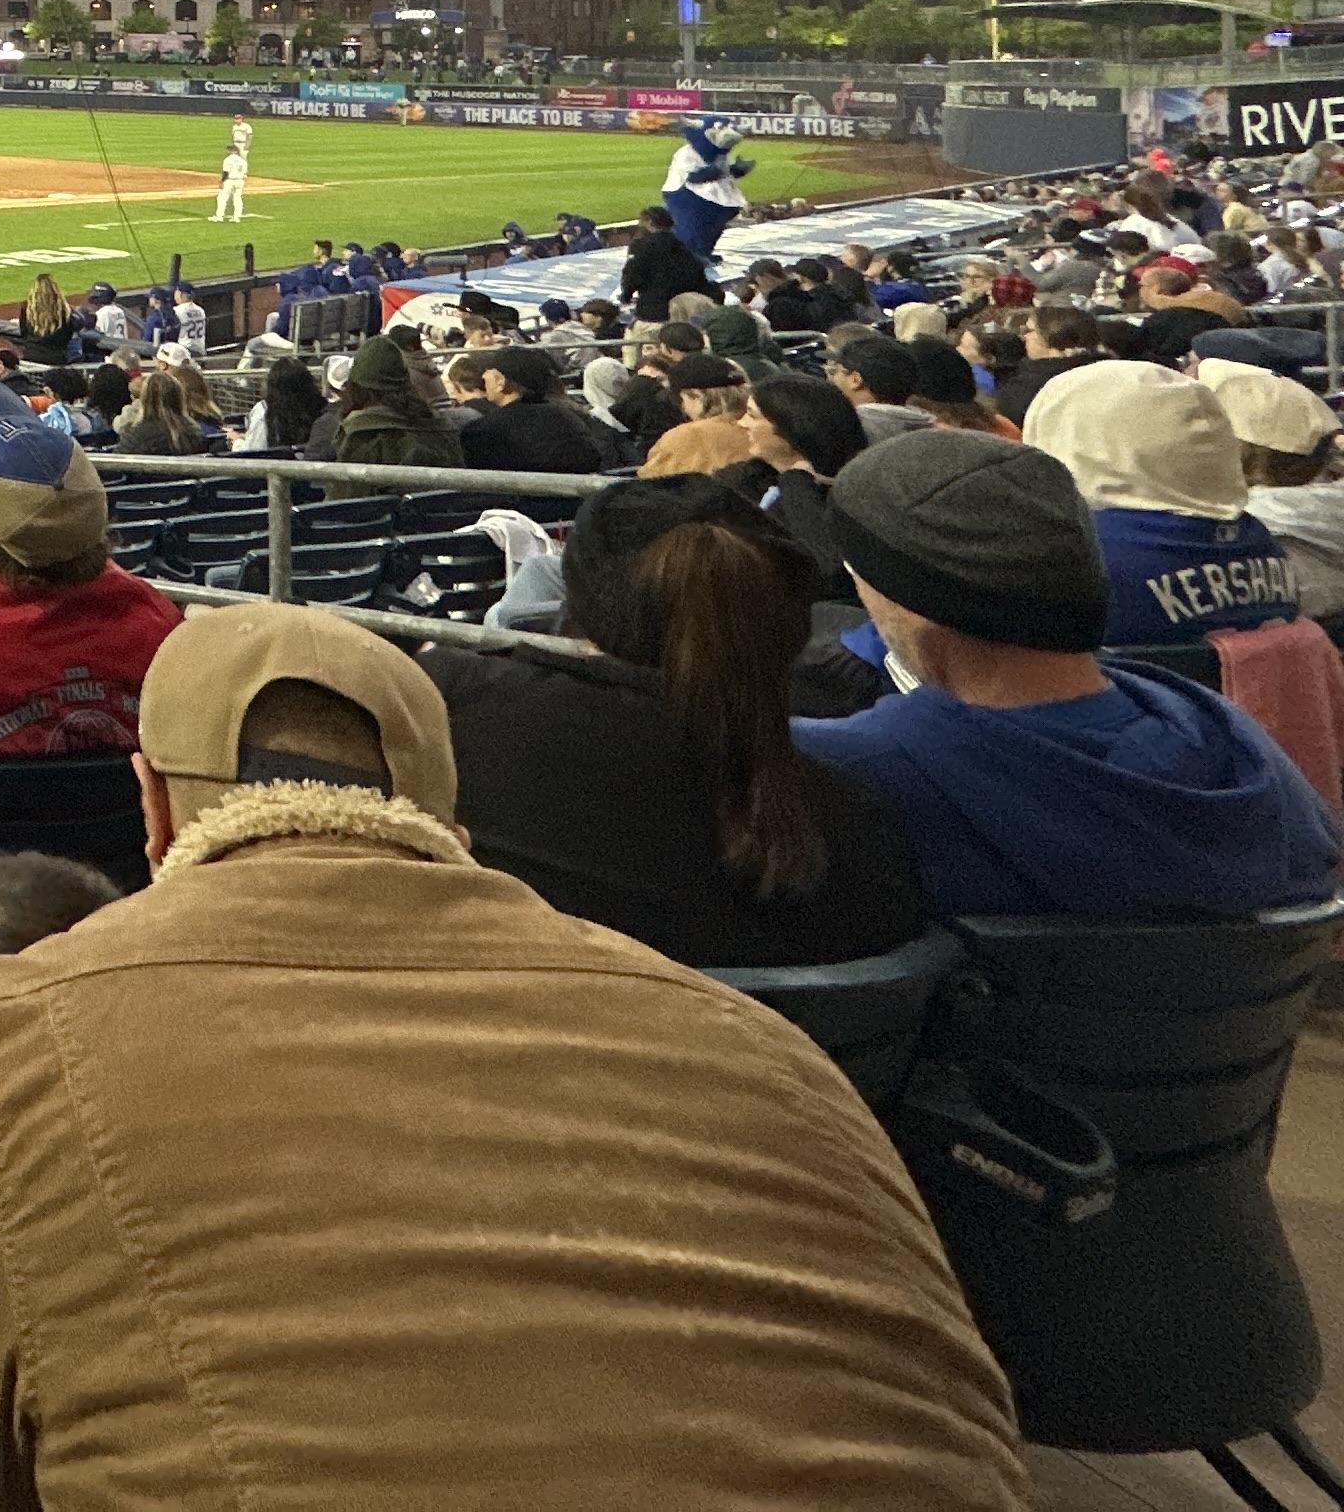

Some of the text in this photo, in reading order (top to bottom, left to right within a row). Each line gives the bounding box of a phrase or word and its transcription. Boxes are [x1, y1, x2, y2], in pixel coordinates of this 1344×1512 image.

[451, 91, 501, 99] MUSCOGEE
[503, 92, 541, 100] NATION
[649, 94, 690, 106] Mobile
[270, 100, 366, 118] THE PLACE TO BE
[463, 107, 583, 127] THE PLACE TO BE
[741, 117, 855, 137] PLACE TO BE
[1240, 96, 1344, 147] RIVE
